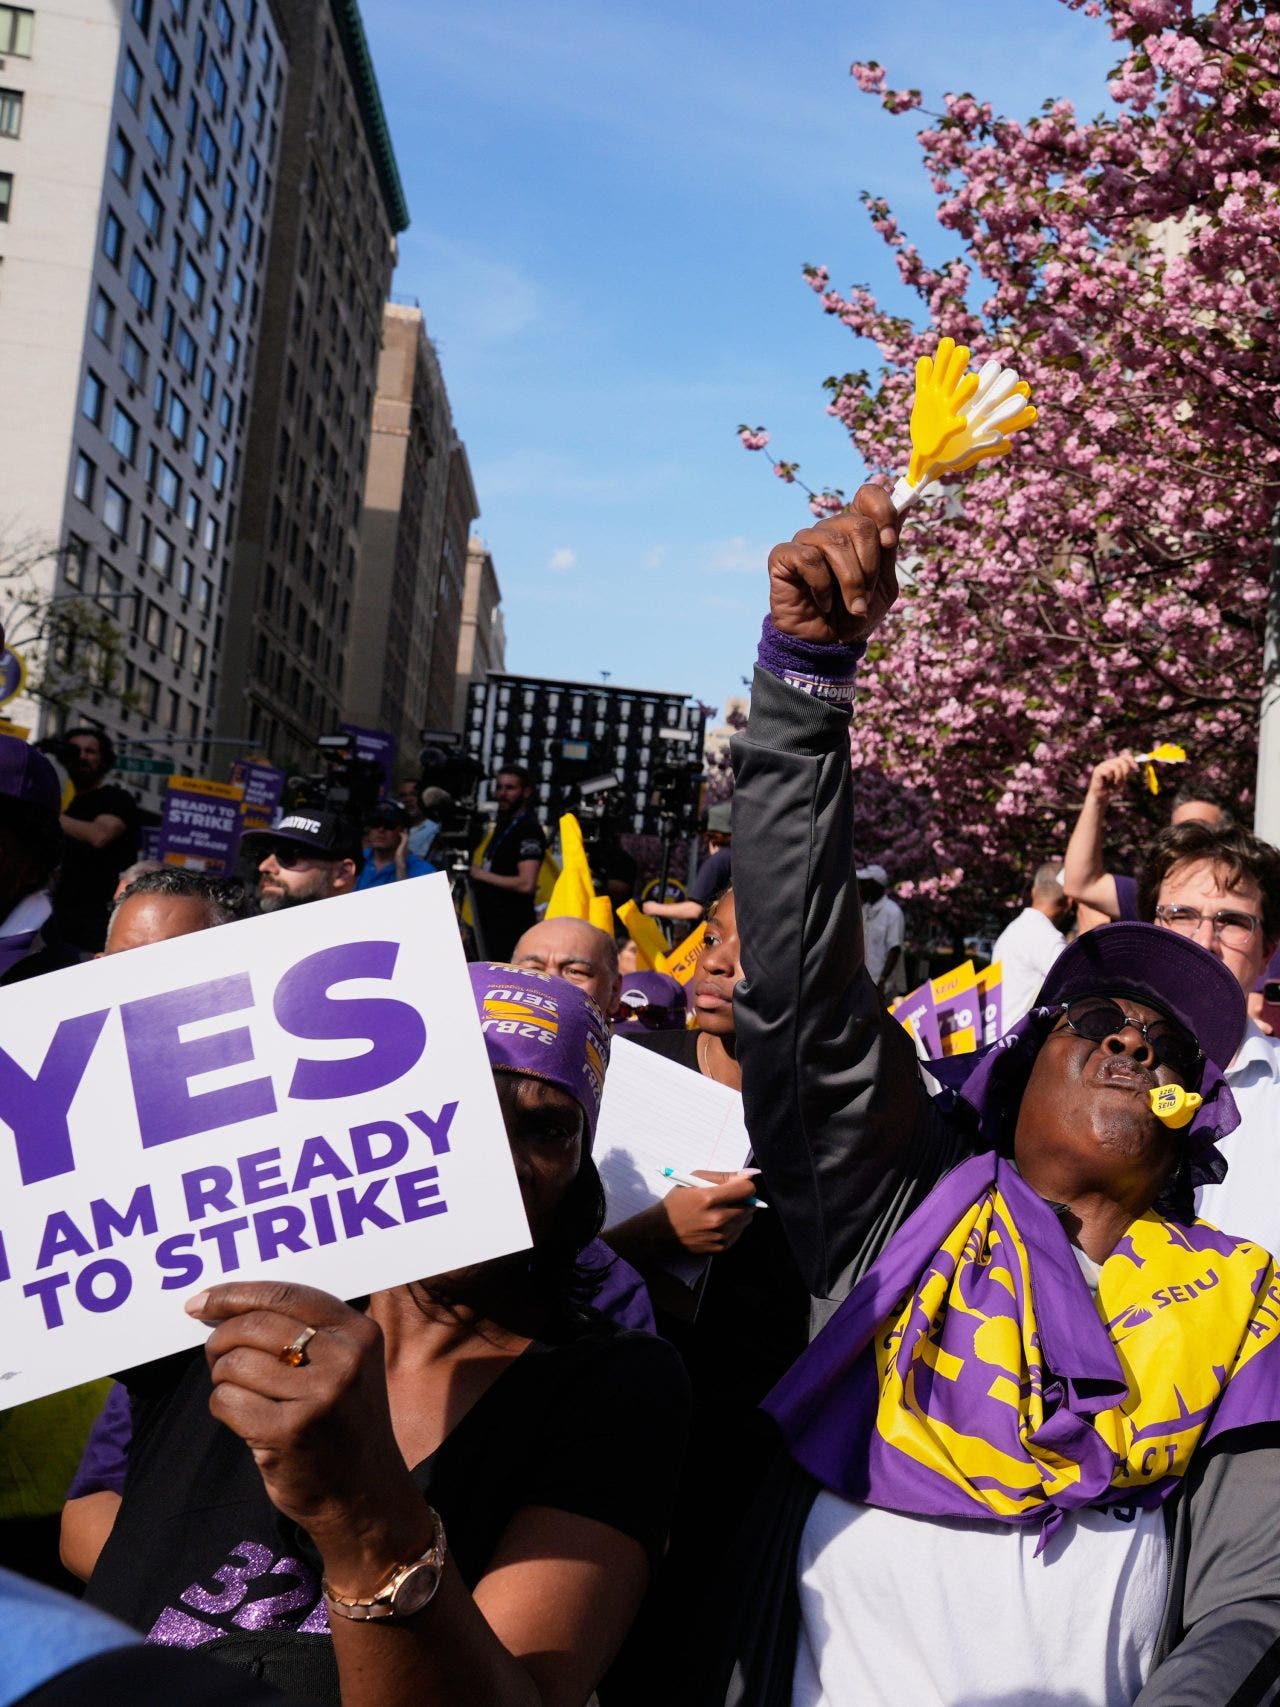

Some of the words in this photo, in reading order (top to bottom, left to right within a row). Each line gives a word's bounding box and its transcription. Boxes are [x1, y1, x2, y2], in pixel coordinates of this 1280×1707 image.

[168, 809, 235, 832] STRIKE
[170, 797, 216, 815] READY
[218, 806, 236, 819] TO
[483, 989, 559, 1012] SEIU
[481, 1019, 558, 1046] 32BJ
[0, 940, 427, 1187] YES
[36, 1184, 158, 1270] AM
[181, 1101, 460, 1222] READY
[22, 1258, 133, 1331] TO
[155, 1165, 448, 1290] STRIKE
[1151, 1268, 1220, 1310] SEIU
